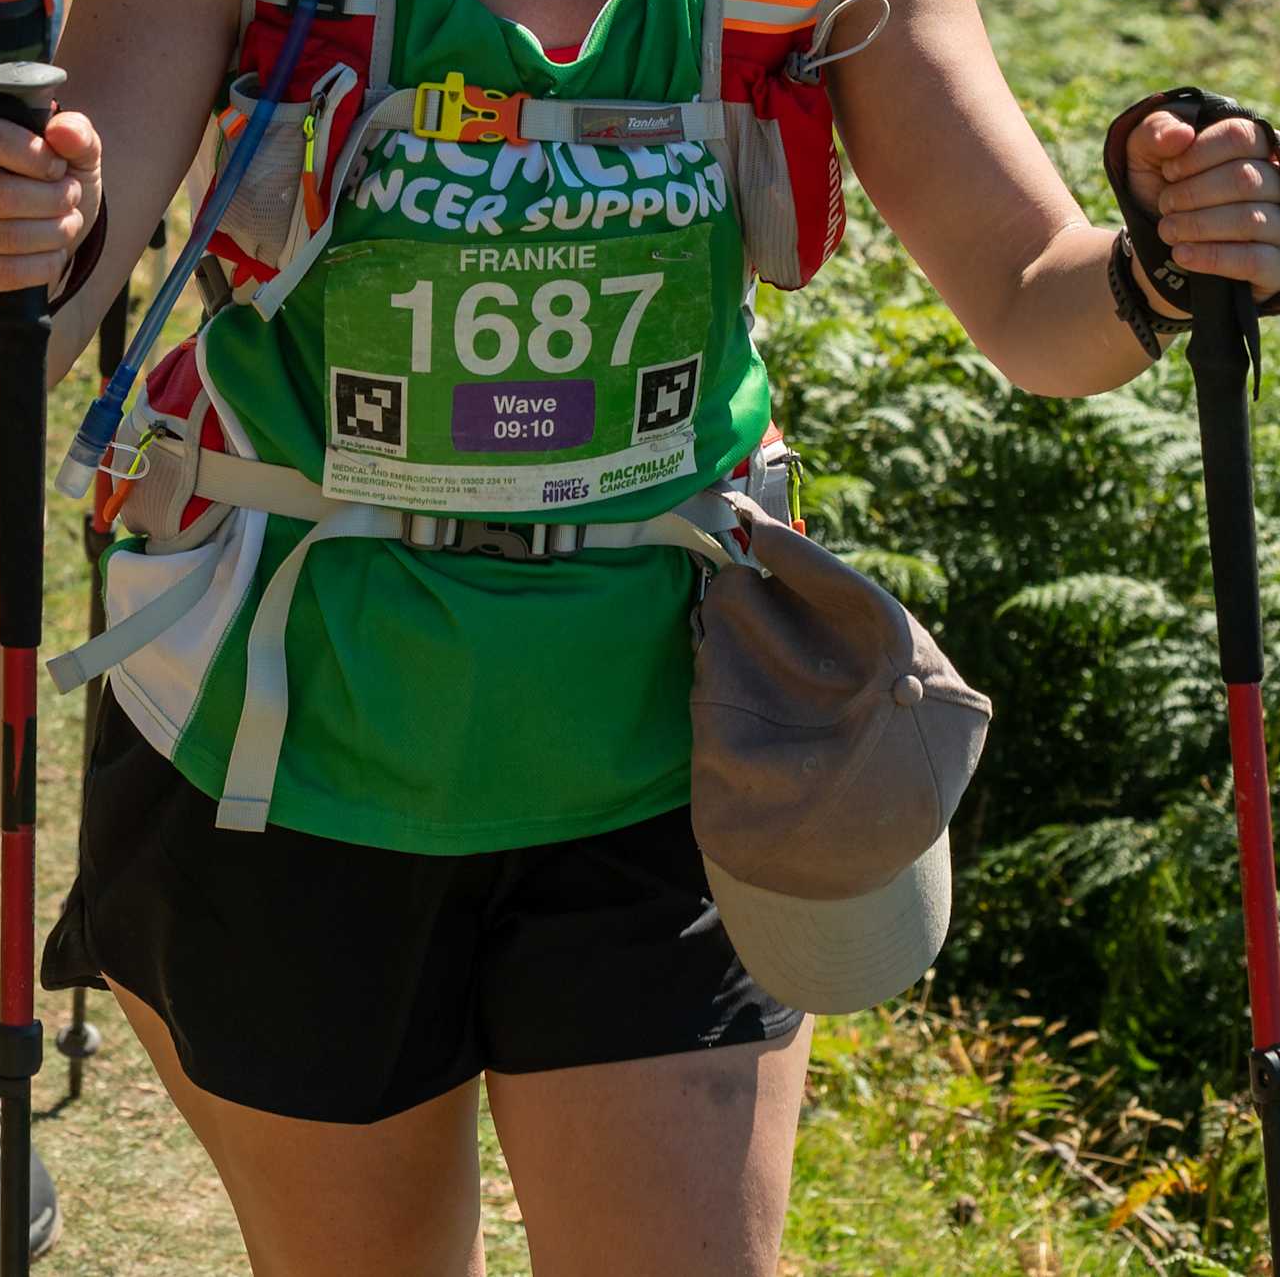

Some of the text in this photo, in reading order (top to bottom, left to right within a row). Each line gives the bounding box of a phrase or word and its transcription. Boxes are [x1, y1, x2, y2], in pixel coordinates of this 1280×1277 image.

[459, 245, 597, 272] FRANKIE
[390, 271, 665, 376] 1687
[493, 394, 557, 414] Wave
[493, 419, 555, 439] 09:10
[332, 463, 369, 475] MEDICAL
[371, 467, 389, 477] AND
[390, 472, 442, 484] EMERGENCY
[599, 450, 685, 485] MACMILLAN
[331, 473, 350, 483] NON
[351, 475, 403, 489] EMERGENCY
[544, 477, 584, 490] MIGHTY
[600, 464, 680, 494] CANCER SUPPORT
[542, 484, 589, 503] HIKES
